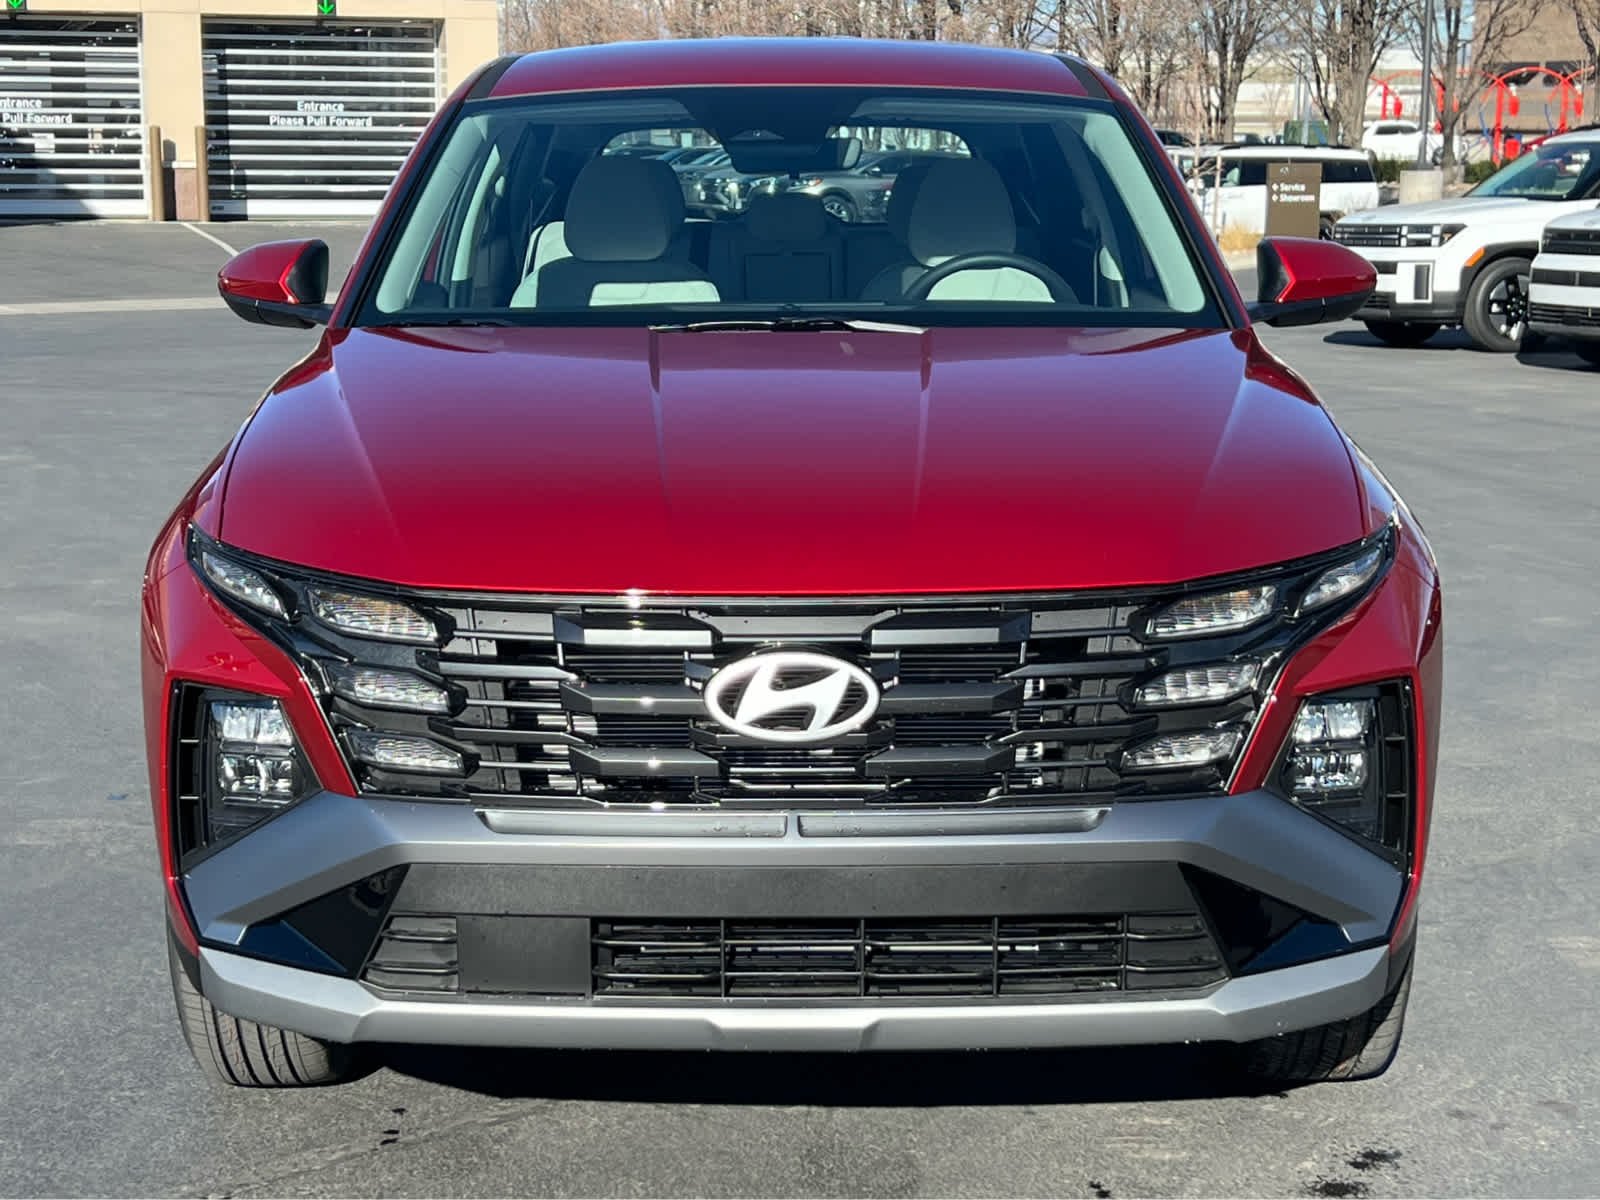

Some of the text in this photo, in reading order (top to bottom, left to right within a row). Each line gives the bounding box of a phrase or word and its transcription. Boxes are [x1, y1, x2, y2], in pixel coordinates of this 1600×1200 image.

[0, 97, 42, 108] ntrance
[296, 101, 345, 112] Entrance
[2, 112, 73, 124] Pull Forward
[269, 115, 373, 127] Please Pull Forward
